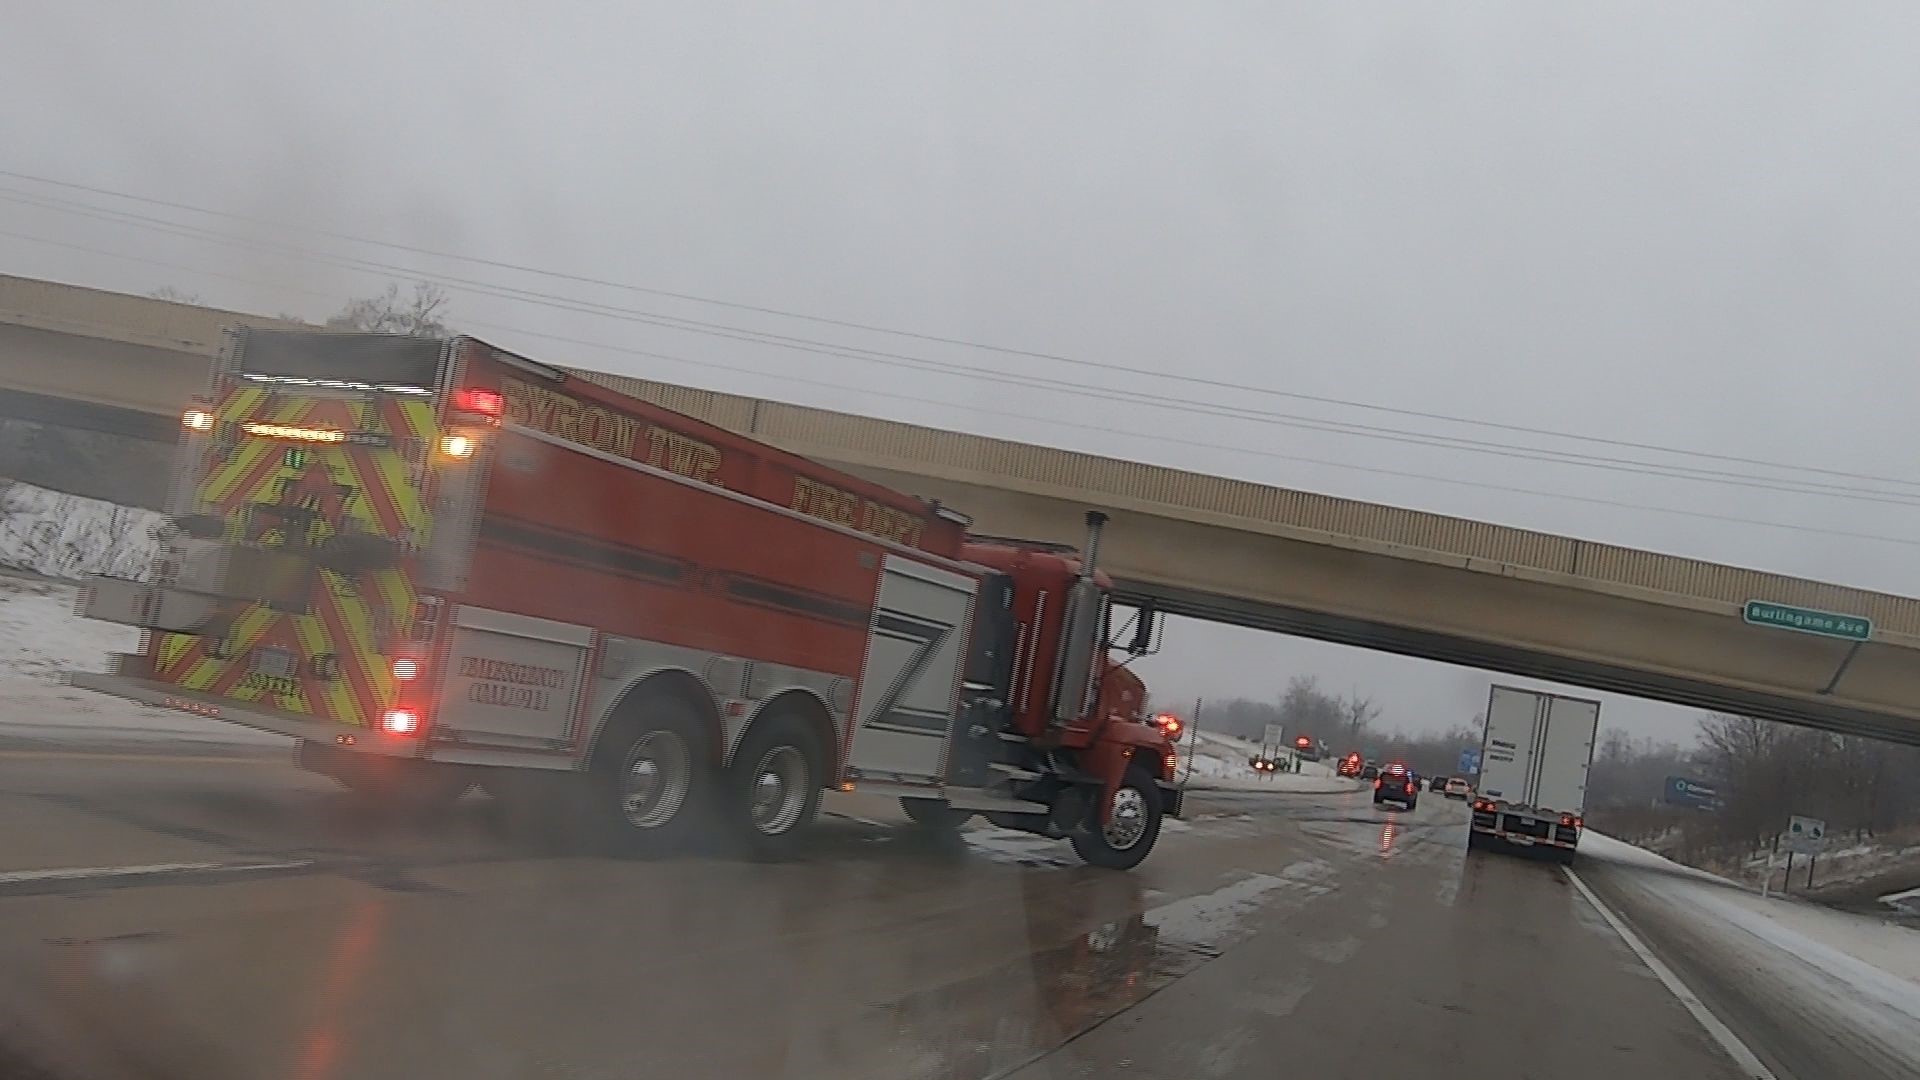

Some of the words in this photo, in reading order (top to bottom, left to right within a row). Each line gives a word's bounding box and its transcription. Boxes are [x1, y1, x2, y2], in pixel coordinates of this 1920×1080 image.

[501, 378, 640, 459] BYRON
[646, 427, 725, 488] TWP.
[791, 475, 858, 529] FIRE
[862, 501, 928, 549] DEPT
[1752, 606, 1833, 629] Burlingame
[1837, 620, 1865, 632] Ave
[457, 656, 568, 690] EMERGENCY
[468, 682, 518, 707] CALL
[515, 687, 551, 712] 911
